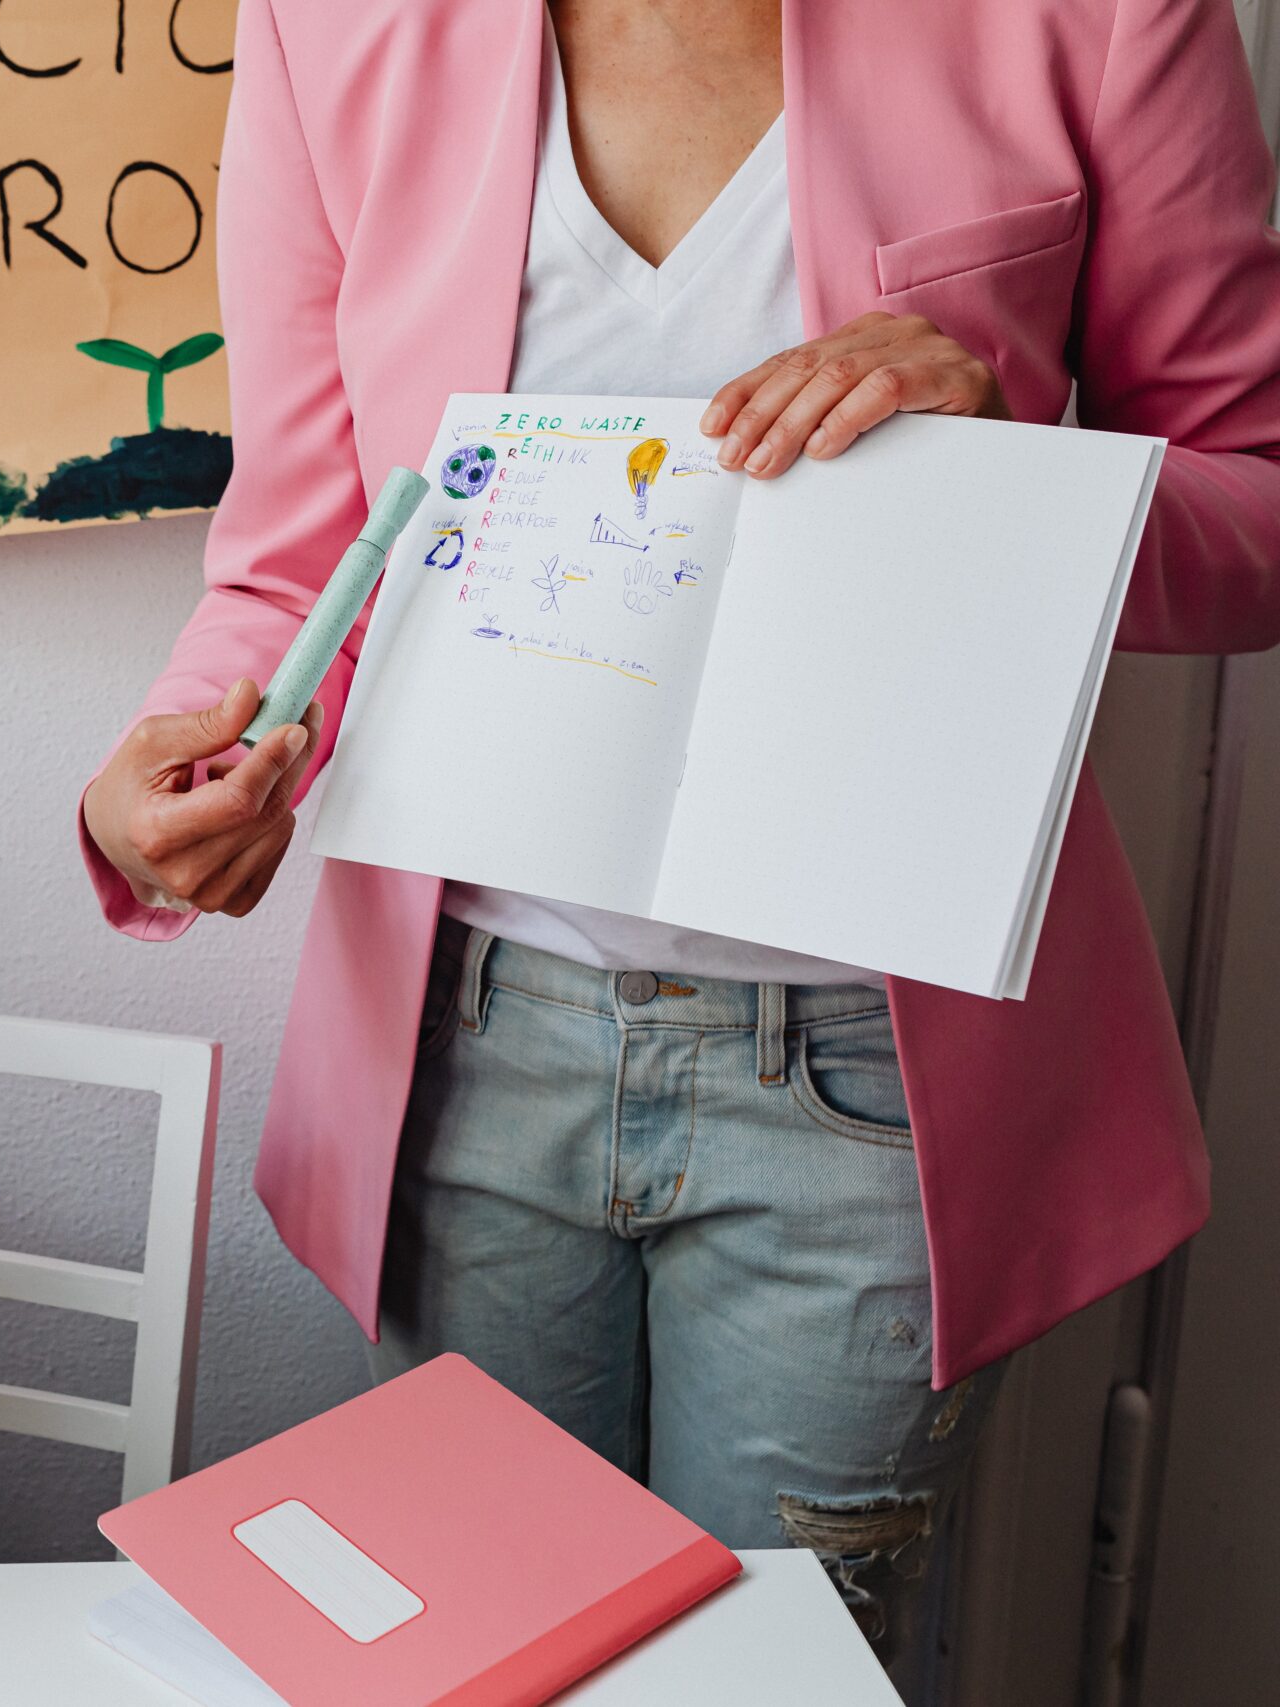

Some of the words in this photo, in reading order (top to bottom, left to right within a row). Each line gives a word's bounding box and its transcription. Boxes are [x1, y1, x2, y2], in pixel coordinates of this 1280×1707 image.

[496, 413, 562, 430] ZERO
[581, 416, 646, 431] WASTE
[507, 437, 592, 464] RETHINK
[489, 487, 542, 505] REFUSE
[458, 584, 490, 602] ROT
